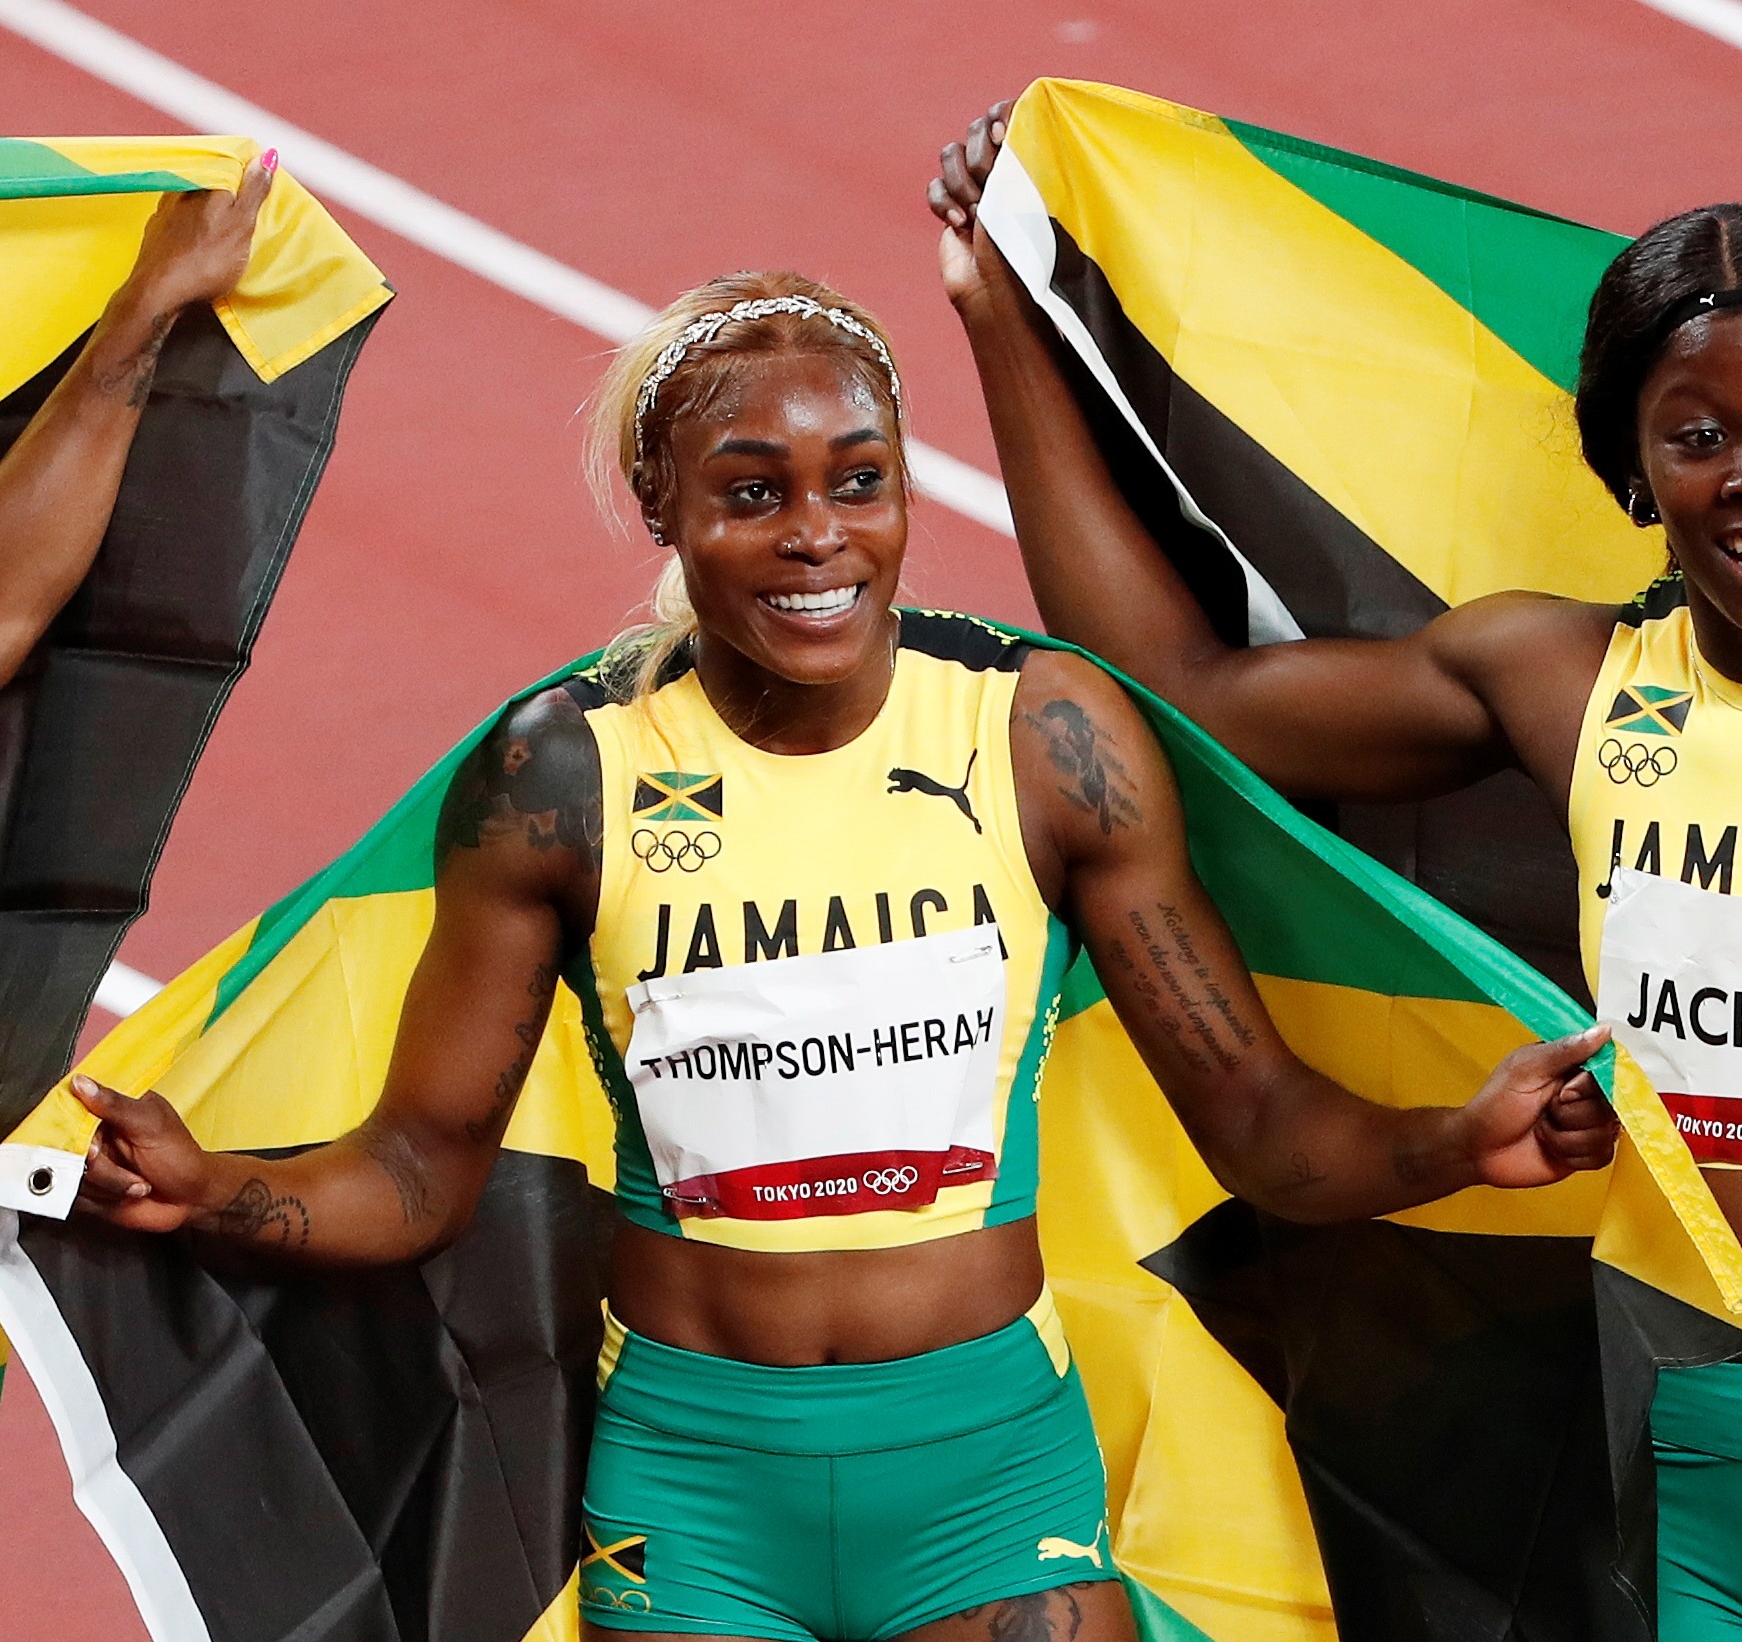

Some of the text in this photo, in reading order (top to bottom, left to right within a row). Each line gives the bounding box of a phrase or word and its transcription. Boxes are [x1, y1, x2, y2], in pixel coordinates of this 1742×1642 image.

[635, 882, 1010, 984] JAMAICA
[639, 1005, 997, 1082] THOMPSON-HERAH
[1676, 1113, 1723, 1138] TOKYO
[752, 1177, 858, 1202] TOKYO 2020
